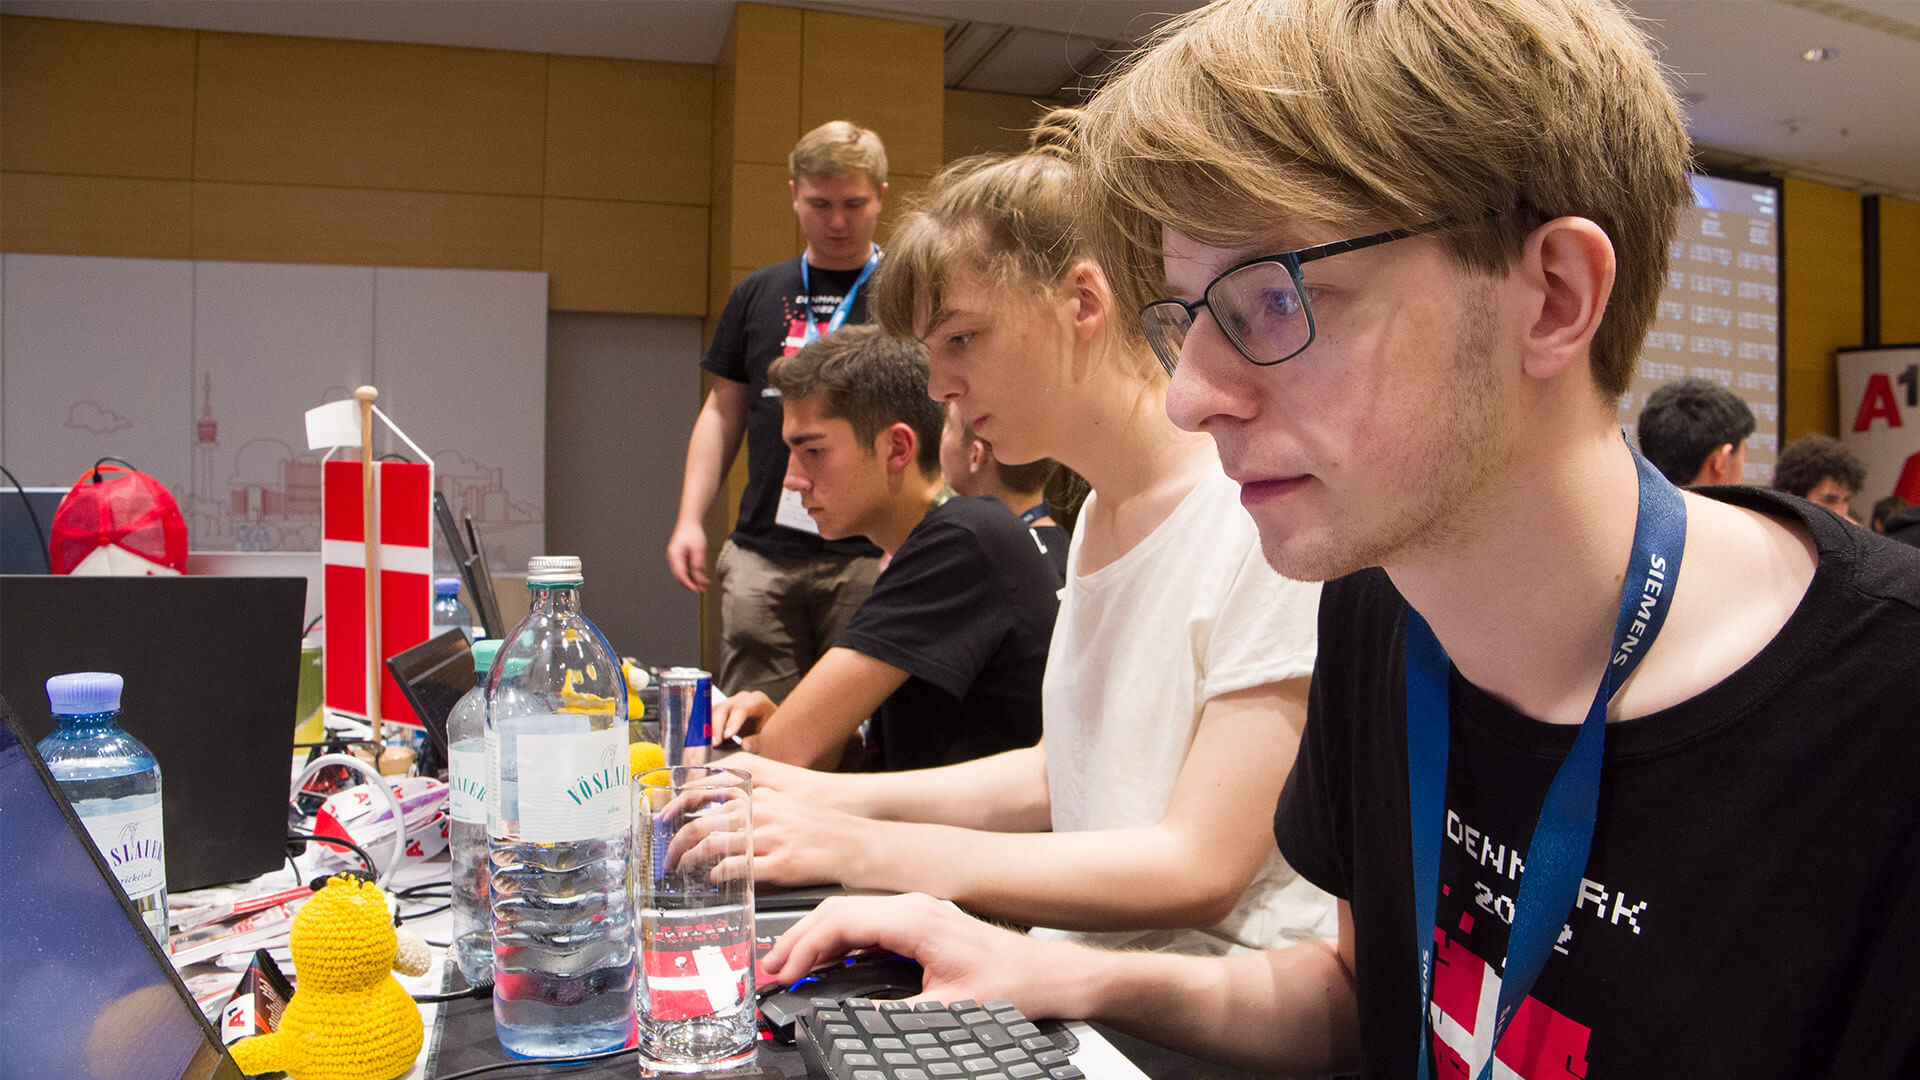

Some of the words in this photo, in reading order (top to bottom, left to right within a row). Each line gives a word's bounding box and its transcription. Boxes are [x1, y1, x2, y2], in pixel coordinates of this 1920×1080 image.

[1853, 364, 1919, 433] A1
[1613, 553, 1667, 666] SIEMENS
[567, 764, 629, 806] VÖSLAU
[119, 868, 153, 885] rickelnd
[1447, 809, 1648, 935] DENMRK
[1474, 880, 1574, 956] 202
[227, 1006, 246, 1027] A1
